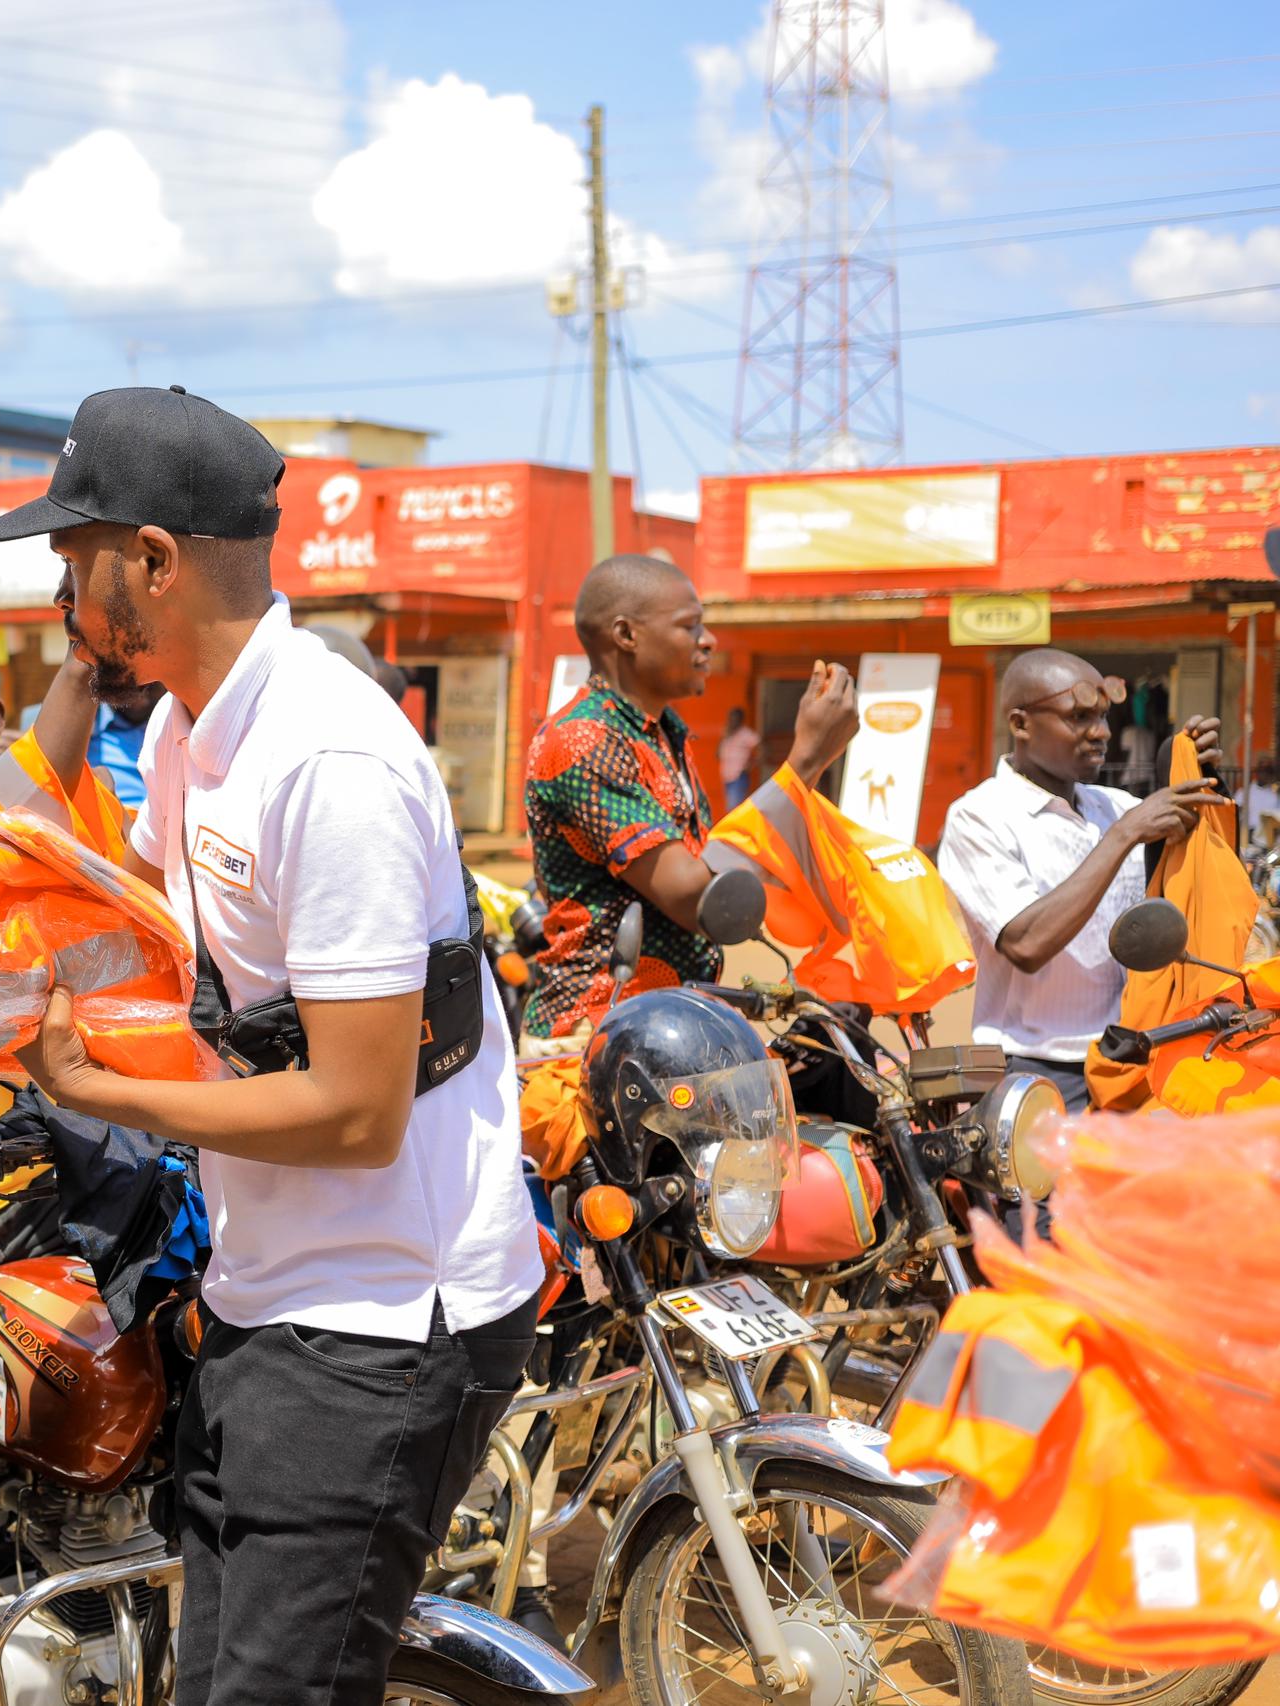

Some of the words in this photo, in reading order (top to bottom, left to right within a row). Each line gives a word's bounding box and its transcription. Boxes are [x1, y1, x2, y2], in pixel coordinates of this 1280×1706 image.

[299, 529, 377, 571] airtel
[434, 1045, 465, 1071] GULU
[696, 1279, 768, 1313] UFZ
[725, 1308, 804, 1347] 616E
[3, 1316, 80, 1391] BOXER
